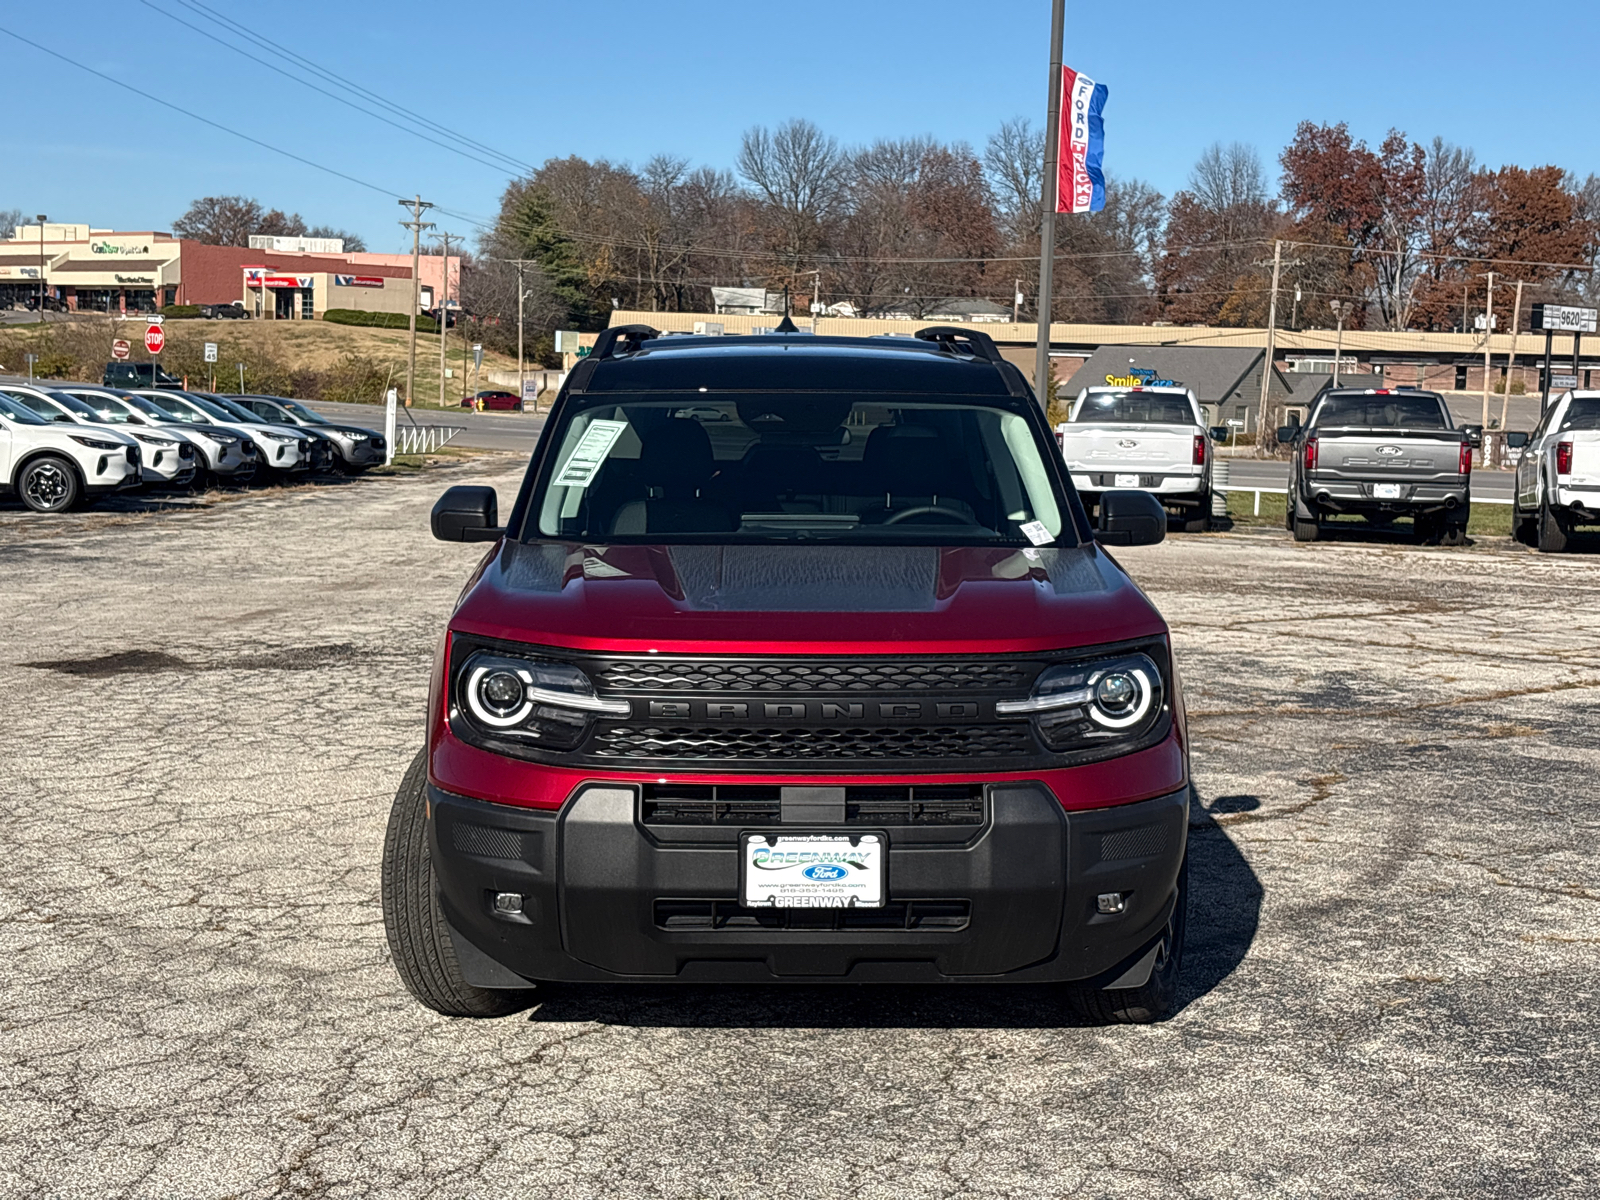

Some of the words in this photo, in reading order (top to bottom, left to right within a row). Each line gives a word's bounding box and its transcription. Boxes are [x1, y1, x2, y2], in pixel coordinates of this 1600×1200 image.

[1075, 86, 1087, 138] FORD
[1561, 311, 1579, 326] 9620
[147, 333, 162, 344] STOP
[1105, 374, 1141, 387] Smile
[1143, 375, 1173, 387] Care
[1342, 457, 1434, 468] F-150
[650, 702, 978, 719] BRONCO
[777, 835, 849, 843] greenwayfordkc.com
[752, 848, 871, 863] GREENWAY
[811, 867, 838, 879] Ford
[775, 896, 851, 908] GREENWAY
